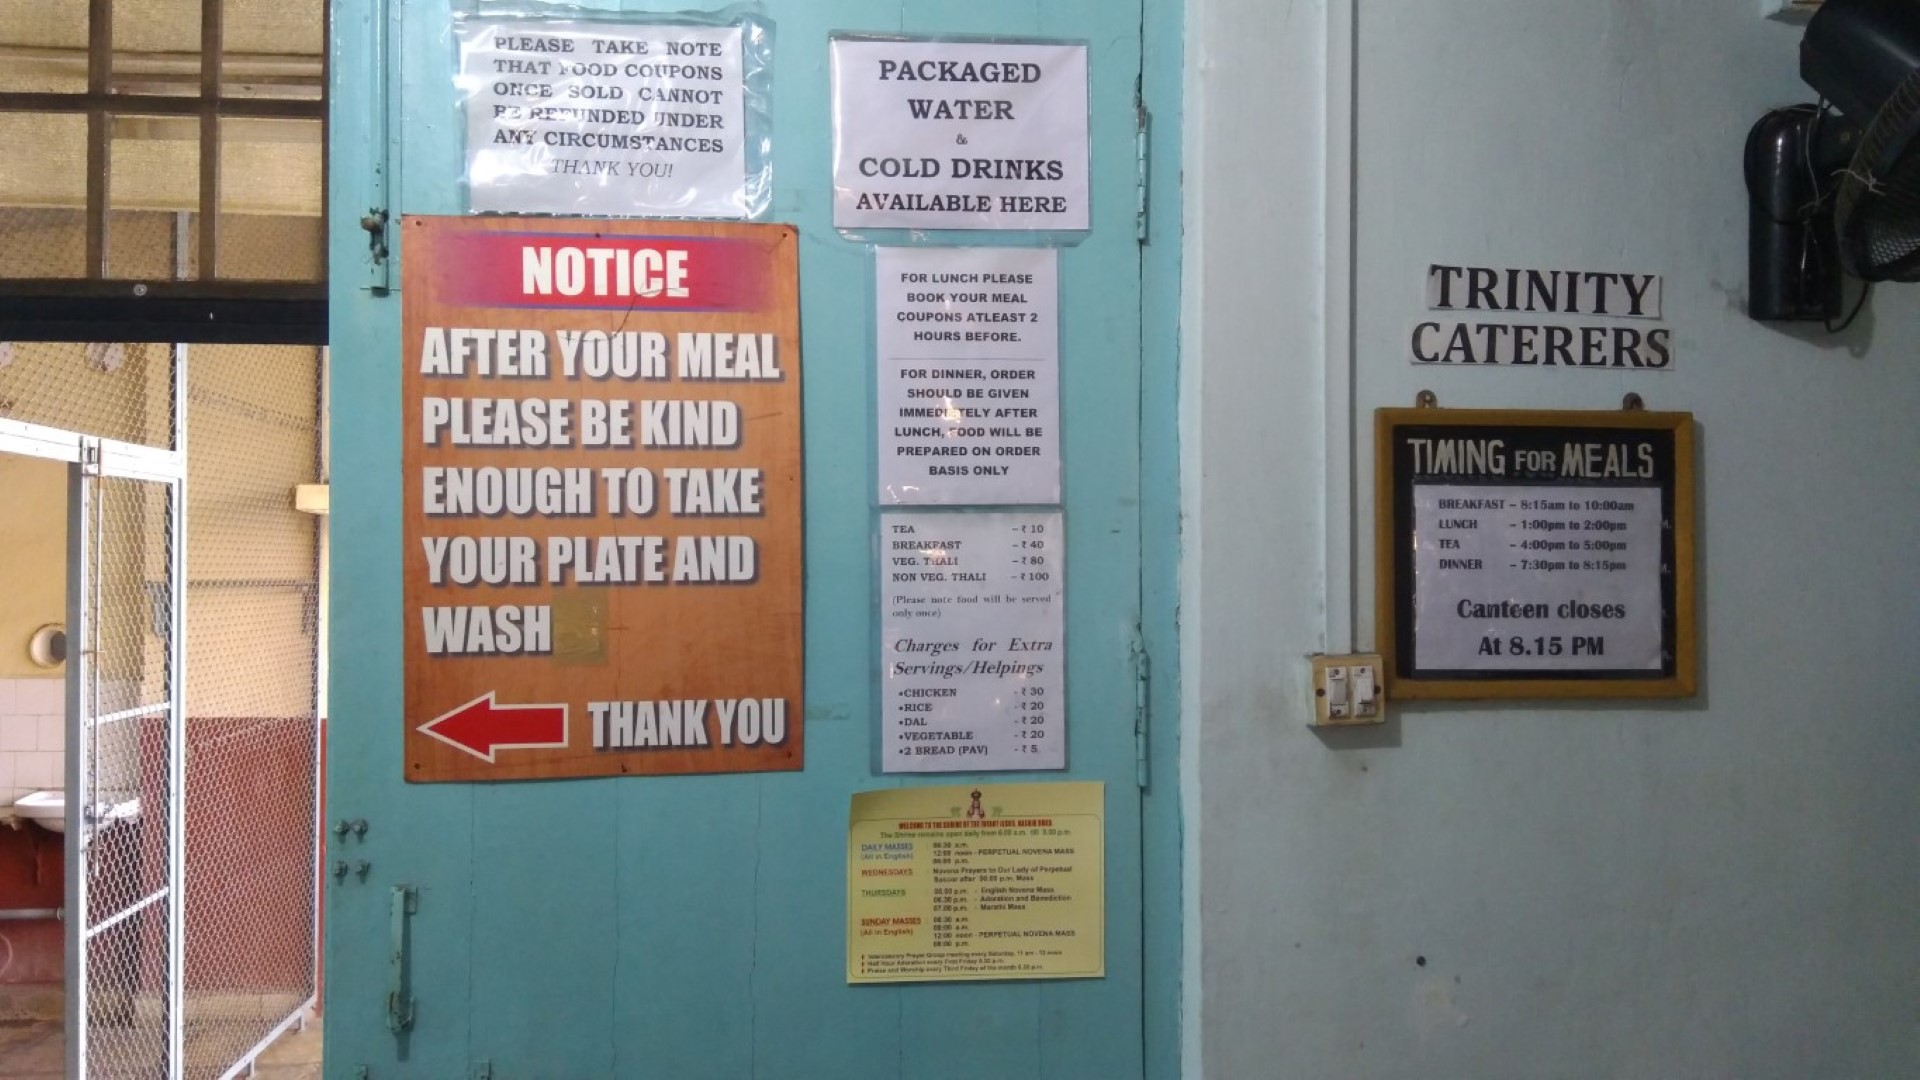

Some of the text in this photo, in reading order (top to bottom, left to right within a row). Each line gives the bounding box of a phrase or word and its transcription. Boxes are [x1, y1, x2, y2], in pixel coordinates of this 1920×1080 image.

[494, 37, 722, 56] PLEASE TAKE NOTE
[493, 59, 723, 80] THAT FOOD COUPONS
[879, 60, 1041, 83] PACKAGED
[493, 82, 723, 104] ONCE SOLD CANNOT
[907, 99, 1015, 120] WATER
[654, 112, 724, 129] UNDER
[493, 128, 723, 153] ANY CIRCUMSTANCES
[956, 133, 968, 145] &
[551, 158, 673, 178] THANK YOU!
[858, 157, 1064, 180] COLD DRINKS
[856, 192, 1067, 213] AVAILABLE HERE
[521, 247, 690, 297] NOTICE
[901, 273, 1033, 284] FOR LUNCH PLEASE
[906, 293, 1028, 303] BOOK YOUR MEAL
[1430, 264, 1654, 315] TRINITY
[896, 311, 1039, 323] COUPONS ATLEAST 2
[913, 331, 1022, 342] HOURS BEFORE.
[1411, 322, 1671, 368] CATERERS
[420, 327, 780, 380] AFTER YOUR MEAL
[900, 369, 1036, 381] FOR DINNER, ORDER
[907, 388, 1029, 399] SHOULD BE GIVEN
[899, 408, 1037, 418] IMMEDITELY AFTER
[423, 397, 738, 447] PLEASE BE KIND
[894, 427, 945, 439] LUNCH,
[989, 427, 1021, 437] WILL
[1025, 427, 1043, 437] BE
[896, 446, 1041, 456] PREPARED ON ORDER
[1407, 438, 1654, 479] TIMING FOR MEALS
[929, 465, 1009, 476] BASIS ONLY
[423, 467, 760, 515] ENOUGH TO TAKE
[1438, 499, 1635, 511] BREAKFAST 8:15am to 10:00am
[891, 524, 1044, 534] TEA 10
[1439, 519, 1627, 532] LUNCH 1:00pm to 2:00pm
[892, 540, 1044, 550] BREAKFAST 40
[1439, 539, 1627, 551] TEA 4:00pm to 5:00pm
[422, 536, 755, 584] YOUR PLATE AND
[892, 557, 919, 566] VEG.
[923, 557, 959, 566] THALI
[1439, 559, 1627, 571] DINNER 7:30pm to 8:15pm
[892, 572, 1050, 582] NON VEG. THALI 100
[892, 594, 1052, 606] (Please note food will be served
[1456, 598, 1626, 619] Canteen closes
[892, 608, 942, 620] only once)
[422, 605, 551, 654] WASH
[894, 638, 1053, 656] Charges for Extra
[1478, 636, 1604, 656] At 8.15 PM
[893, 660, 1044, 680] Servings/Helpings
[588, 698, 785, 748] THANK YOU
[915, 746, 955, 755] BREAD
[958, 745, 988, 756] (PAV)
